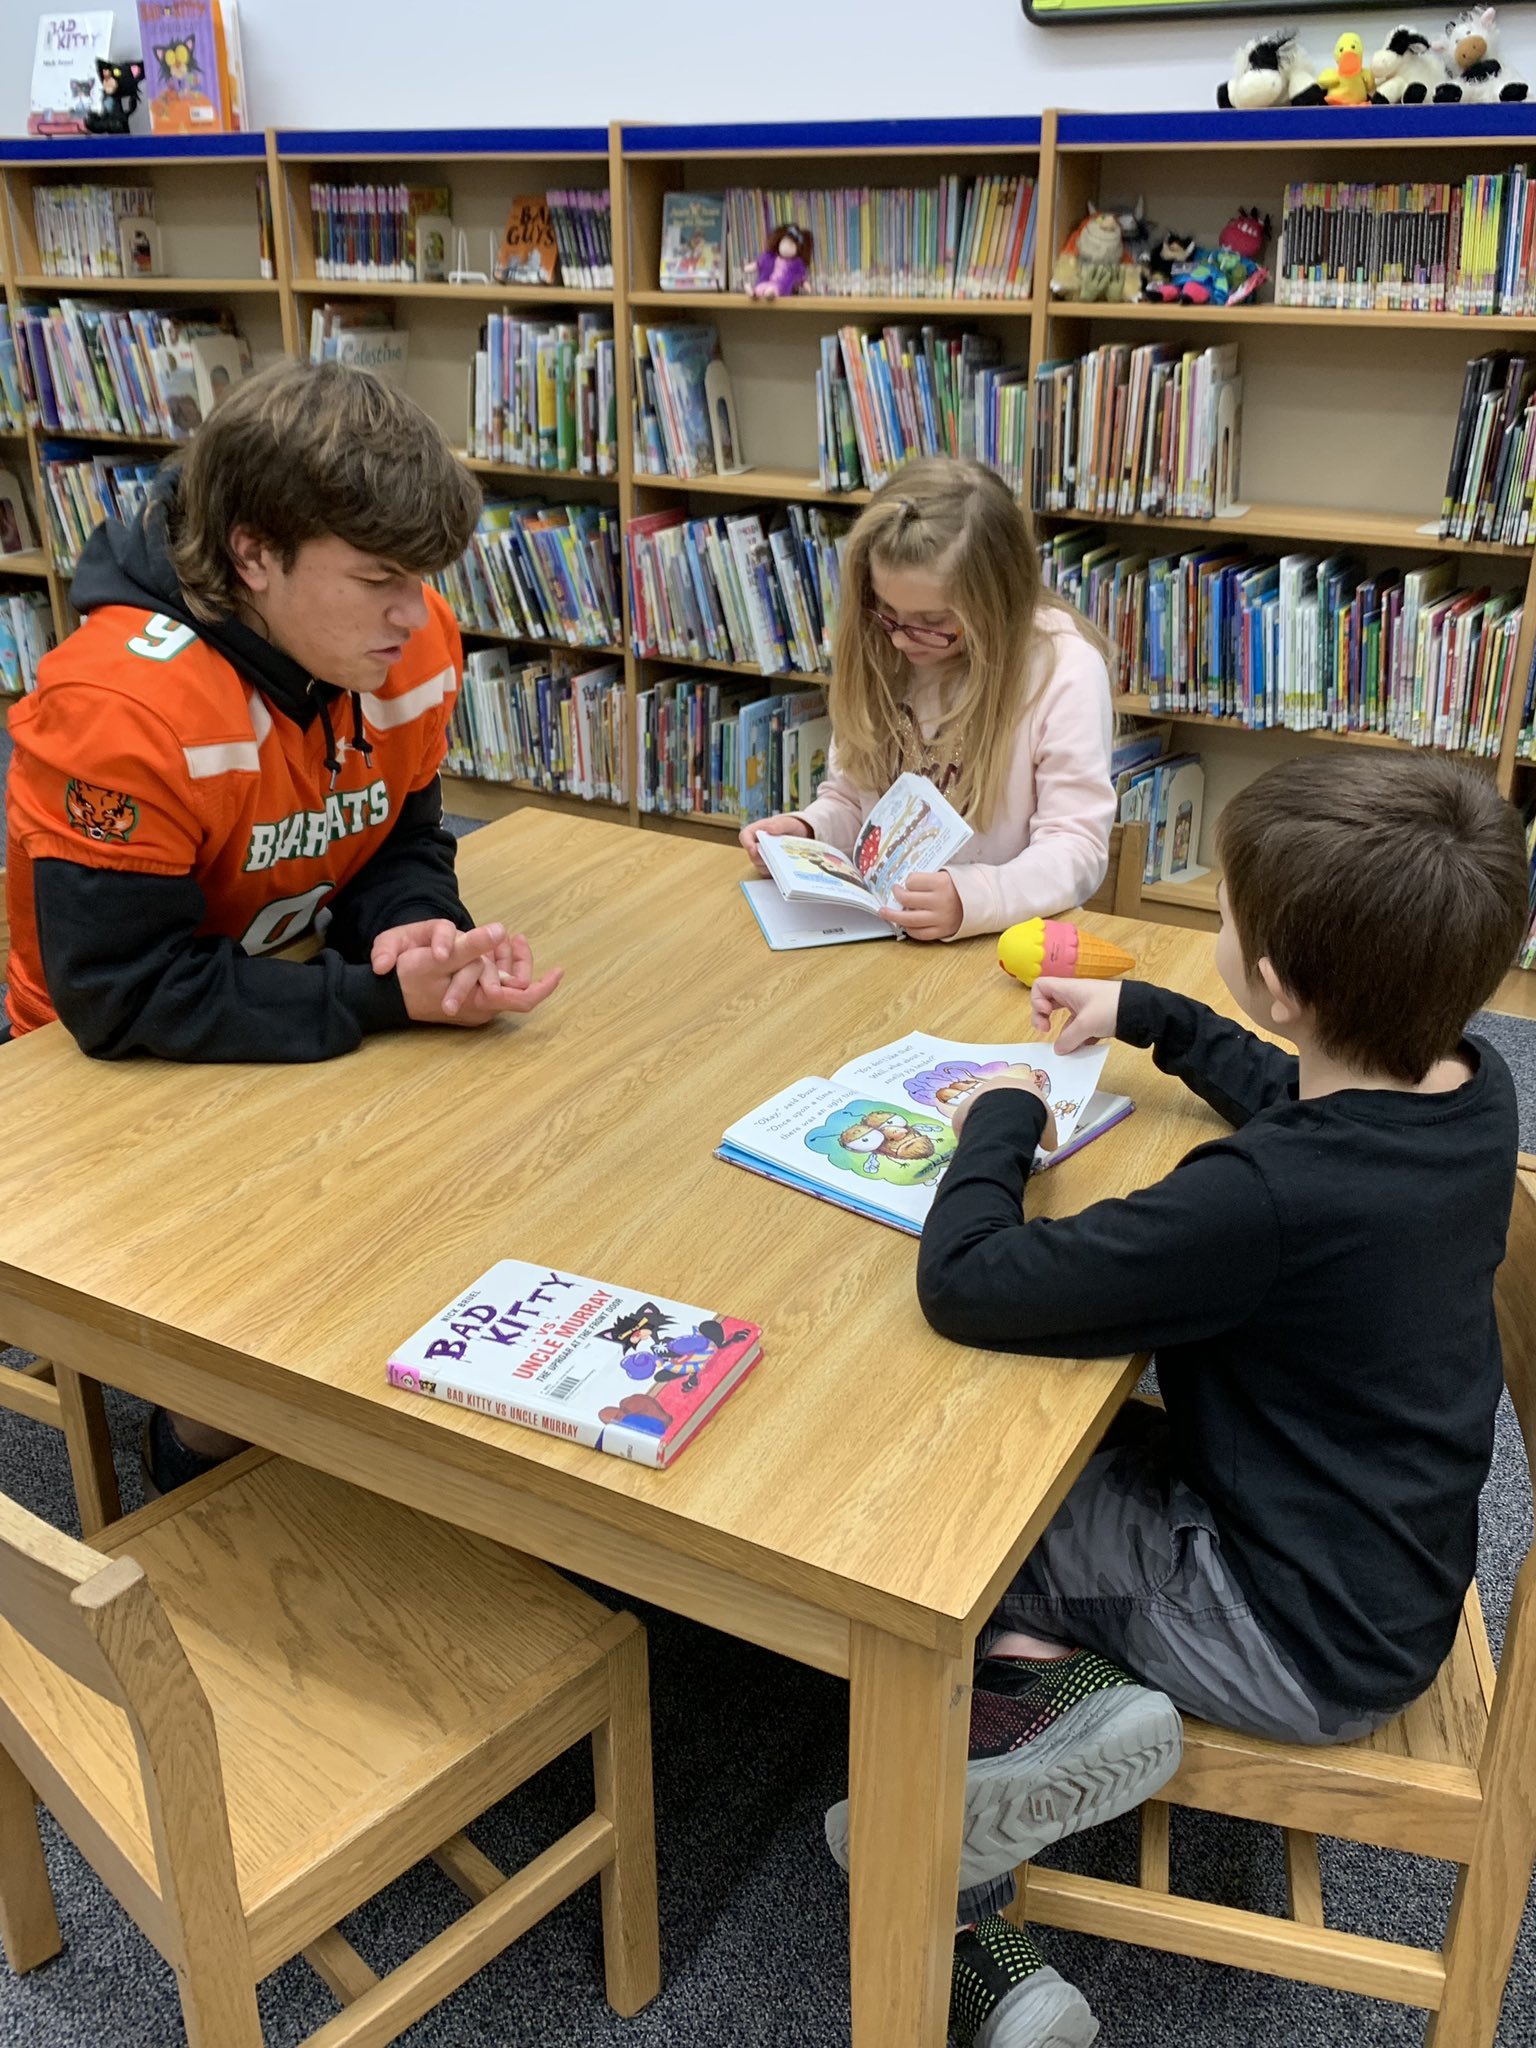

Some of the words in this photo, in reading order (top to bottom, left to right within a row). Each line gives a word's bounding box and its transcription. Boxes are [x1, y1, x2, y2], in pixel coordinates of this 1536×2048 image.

[57, 33, 101, 51] KITTY
[506, 225, 555, 246] GUYS
[242, 779, 390, 873] BARATS
[424, 1304, 498, 1361] BAD
[440, 1306, 460, 1323] NICK
[457, 1289, 482, 1309] BRUEL
[480, 1272, 578, 1347] KITTY
[536, 1321, 557, 1336] VS
[512, 1338, 564, 1380] UNCLE
[553, 1289, 613, 1339] MURRAY
[536, 1369, 552, 1383] THE
[550, 1348, 574, 1372] UPROAR
[577, 1327, 592, 1342] THE
[588, 1312, 609, 1331] FRONT
[447, 1387, 464, 1404] BAD
[466, 1394, 493, 1412] KITTY
[495, 1402, 507, 1417] VS
[510, 1408, 538, 1427] UNCLE
[541, 1416, 579, 1439] MURRAY
